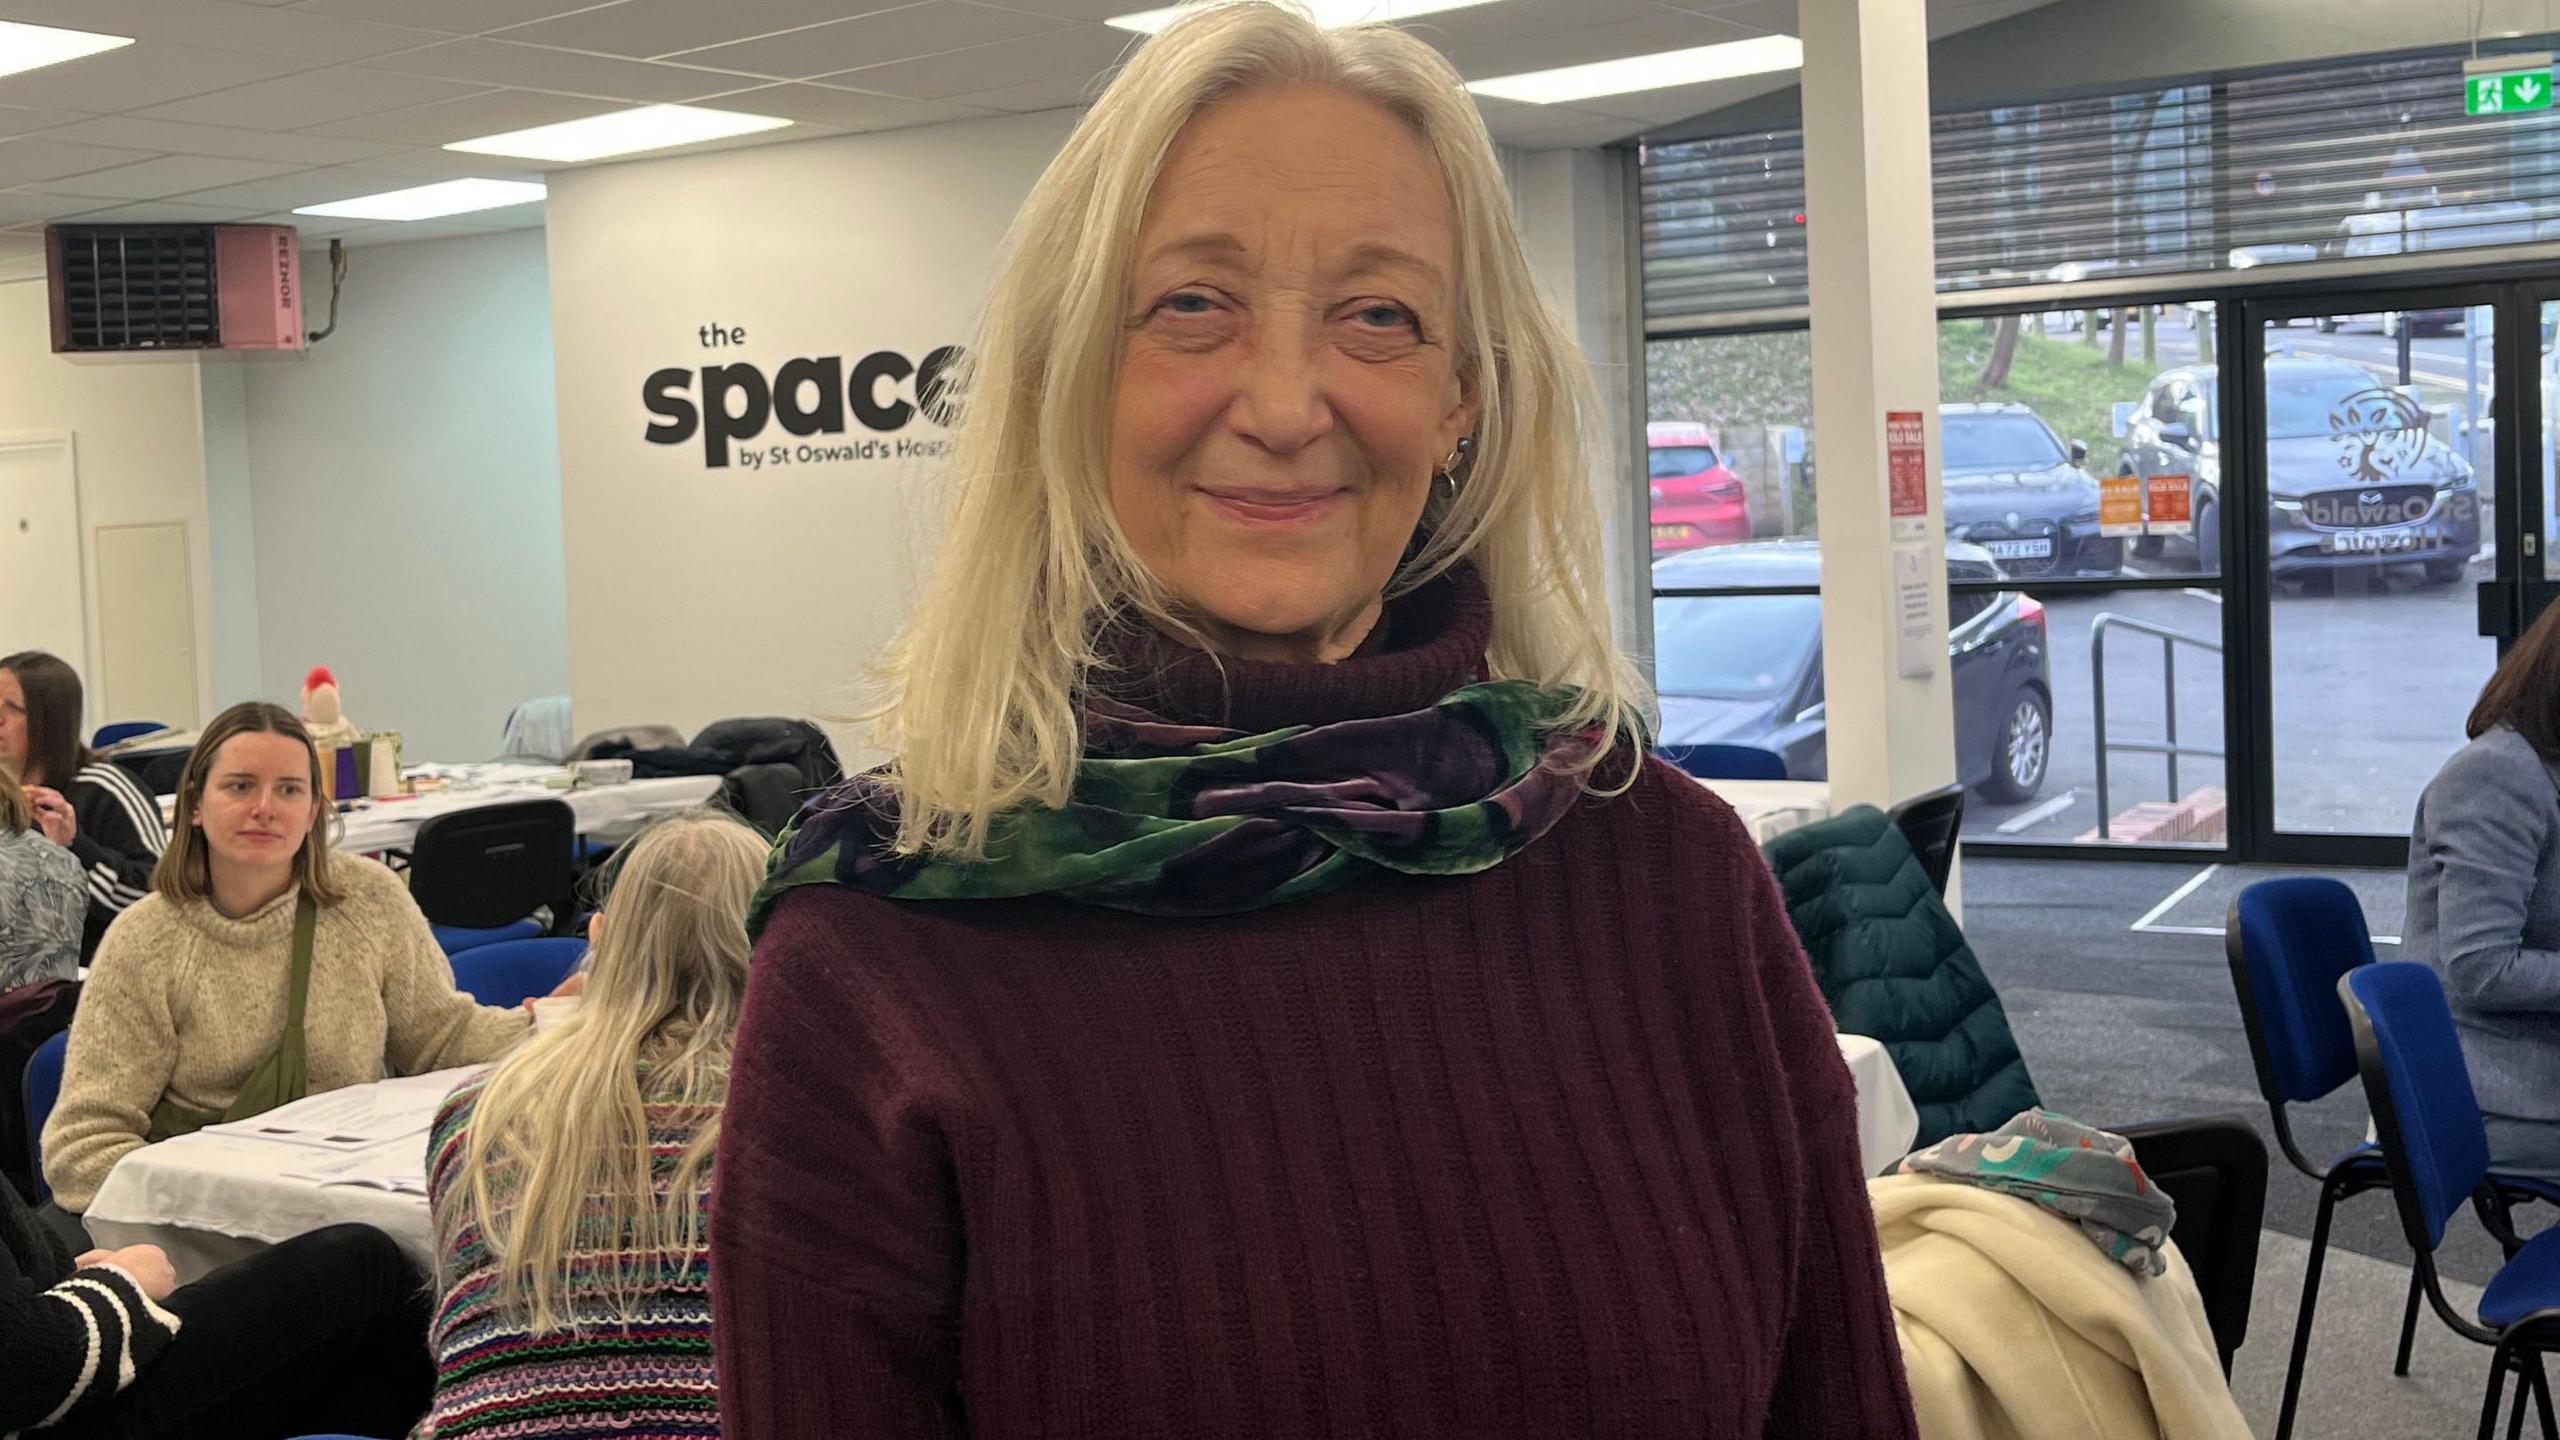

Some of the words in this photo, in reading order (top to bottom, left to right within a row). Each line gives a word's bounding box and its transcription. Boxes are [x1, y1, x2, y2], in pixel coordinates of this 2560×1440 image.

[278, 235, 291, 309] REZNOR
[699, 322, 746, 348] the
[740, 448, 764, 471] by
[770, 446, 789, 465] St
[796, 440, 890, 463] Oswald's
